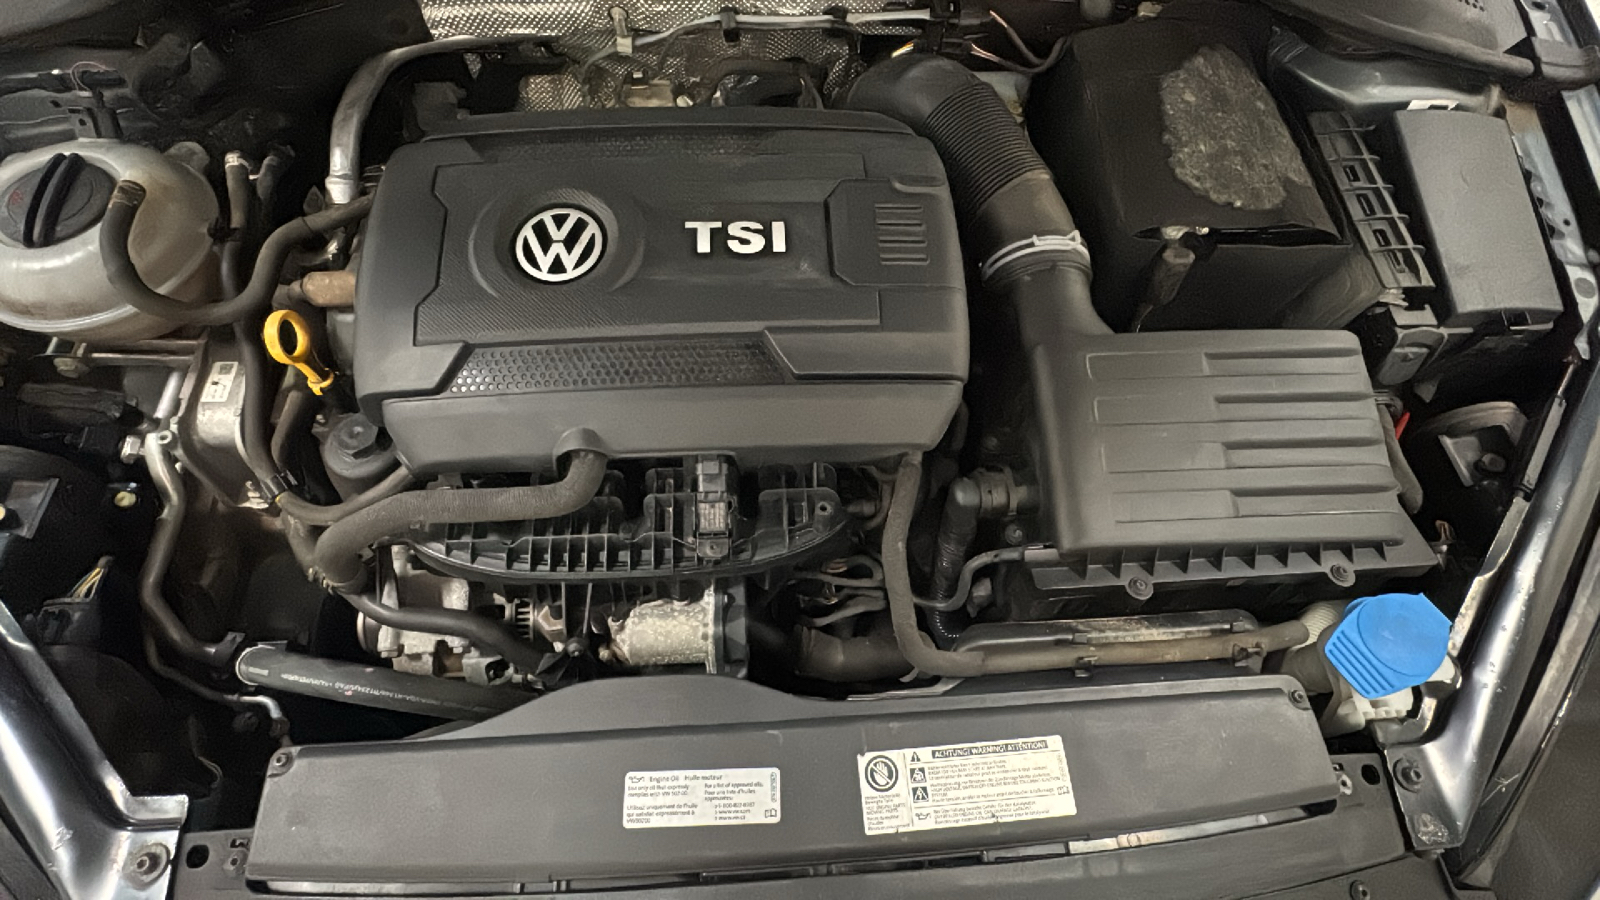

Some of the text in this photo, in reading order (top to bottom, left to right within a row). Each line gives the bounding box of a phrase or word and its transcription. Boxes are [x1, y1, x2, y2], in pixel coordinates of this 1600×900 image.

[516, 207, 603, 282] VW
[685, 221, 786, 254] TSI
[935, 741, 1046, 758] ACHTUNG! WARNING! ATTENTION!
